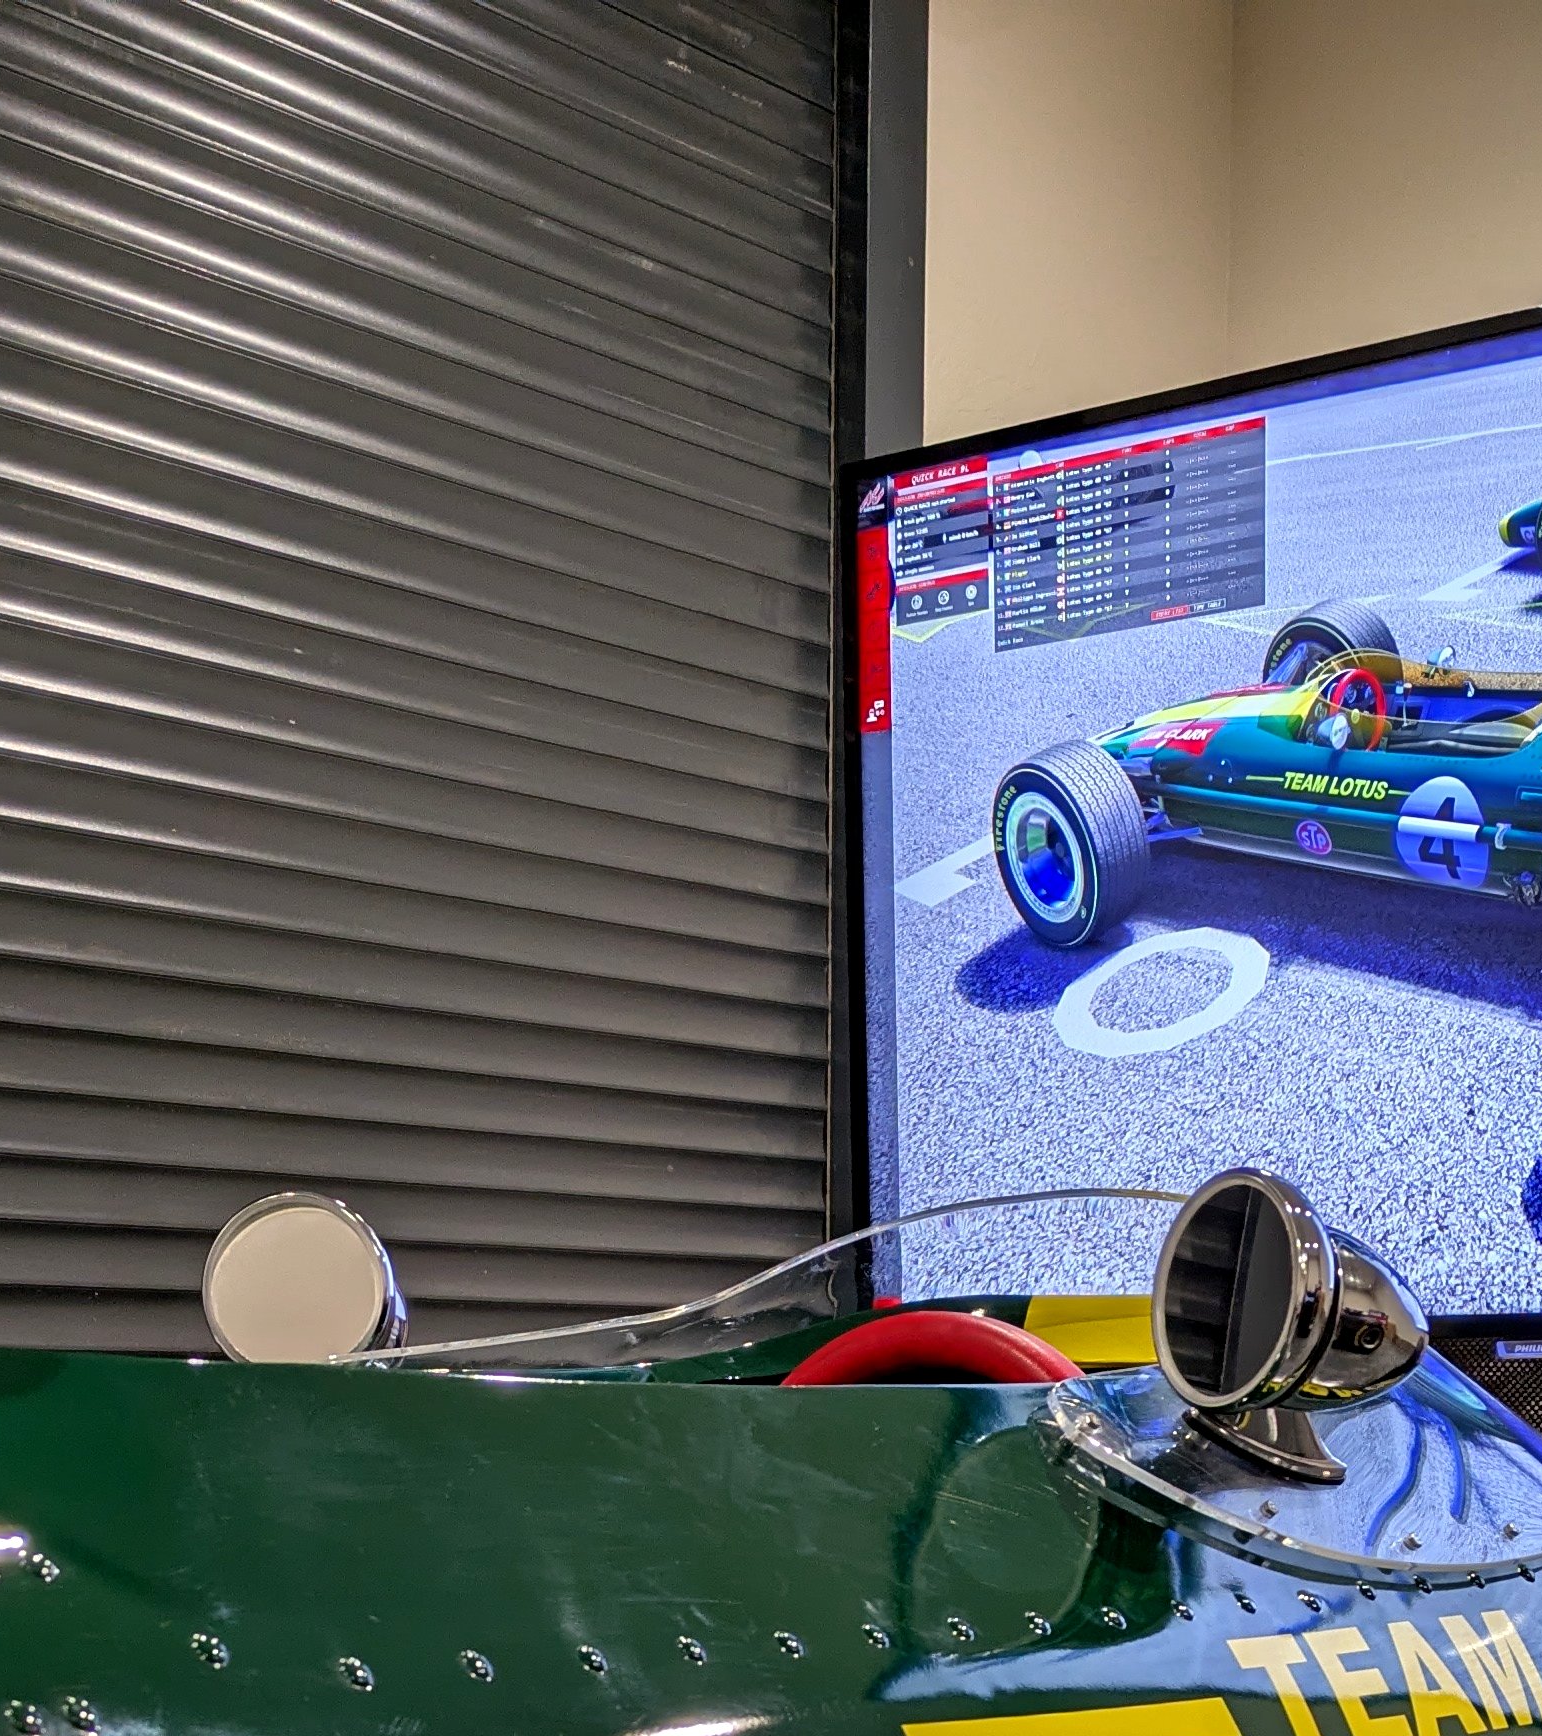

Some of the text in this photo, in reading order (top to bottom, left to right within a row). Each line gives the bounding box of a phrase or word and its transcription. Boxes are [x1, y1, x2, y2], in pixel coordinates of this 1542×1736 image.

[911, 472, 934, 486] QUICK
[938, 466, 957, 478] RACE
[1164, 728, 1213, 741] CLARK
[1284, 771, 1389, 800] TEAM LOTUS
[995, 784, 1018, 853] Firestone
[1302, 825, 1327, 849] STP
[1418, 796, 1462, 880] 4
